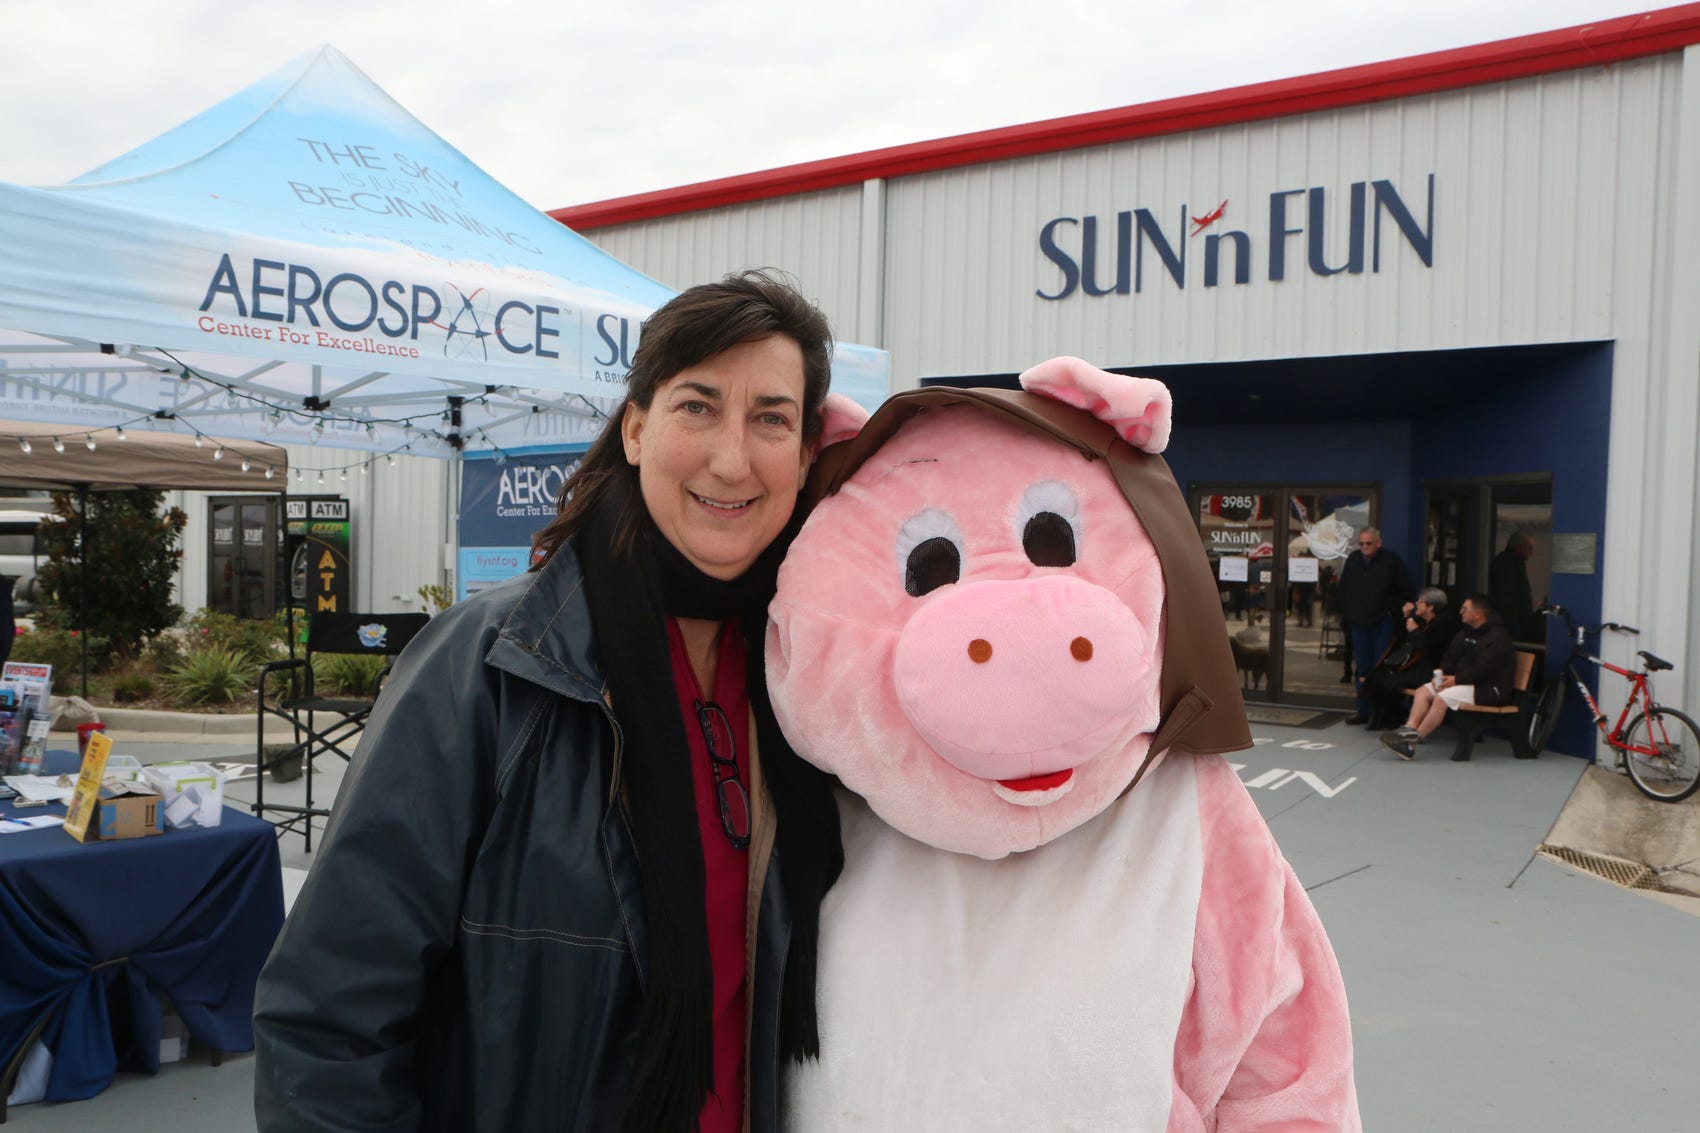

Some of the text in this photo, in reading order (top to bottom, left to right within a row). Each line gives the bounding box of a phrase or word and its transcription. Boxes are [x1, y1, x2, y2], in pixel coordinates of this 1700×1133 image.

[297, 137, 464, 197] THE SKY
[287, 180, 544, 256] BEGINNING
[1035, 203, 1188, 301] SUN
[1267, 172, 1435, 282] FUN
[198, 252, 560, 360] AEROSPACE
[198, 316, 420, 359] Center For Excellence
[594, 313, 642, 369] SU
[315, 503, 343, 516] ATM
[496, 507, 526, 517] Center
[527, 505, 541, 516] For
[1221, 496, 1252, 509] 3985
[318, 549, 337, 613] ATM
